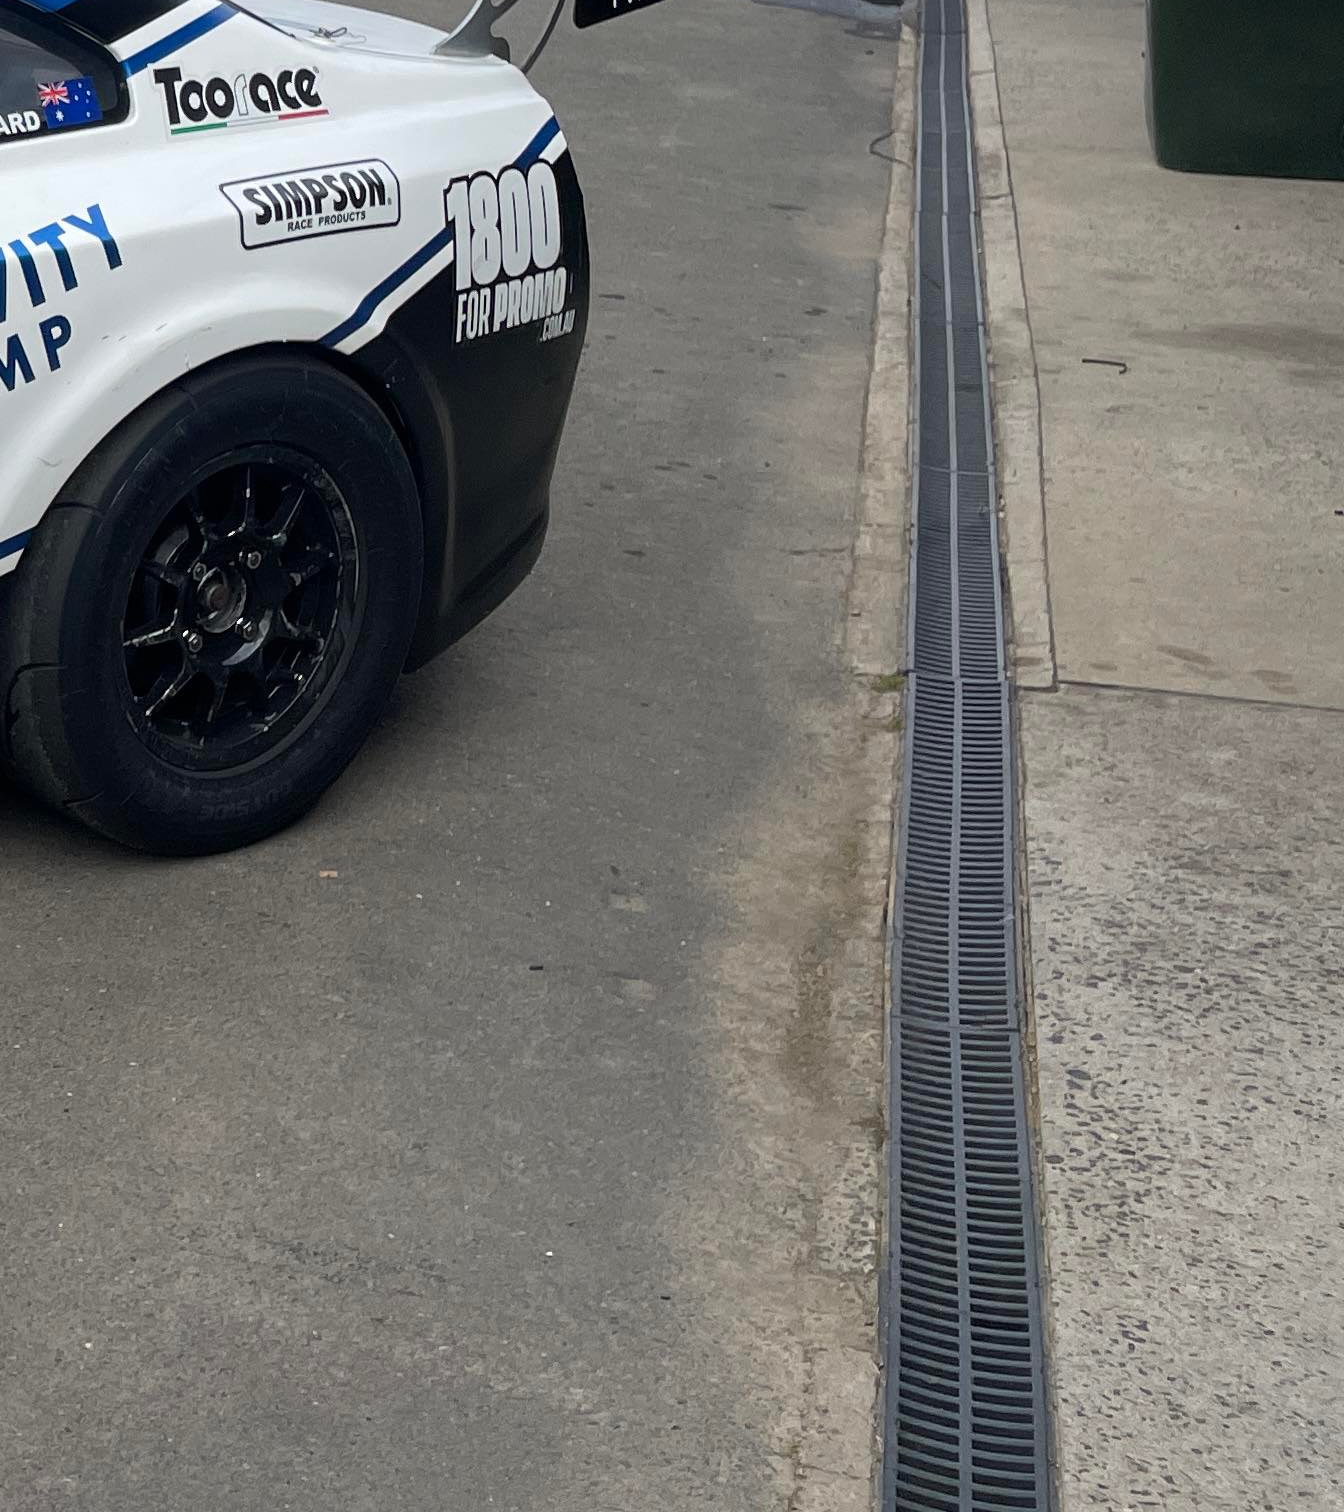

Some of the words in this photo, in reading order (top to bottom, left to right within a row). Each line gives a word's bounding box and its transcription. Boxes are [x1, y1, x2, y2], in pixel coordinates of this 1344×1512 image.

[242, 168, 387, 226] SIMPSON
[287, 219, 313, 232] RACE
[318, 210, 366, 227] PRODUCTS
[445, 161, 562, 291] 1800
[455, 287, 491, 344] FOR
[492, 266, 567, 333] PROMO
